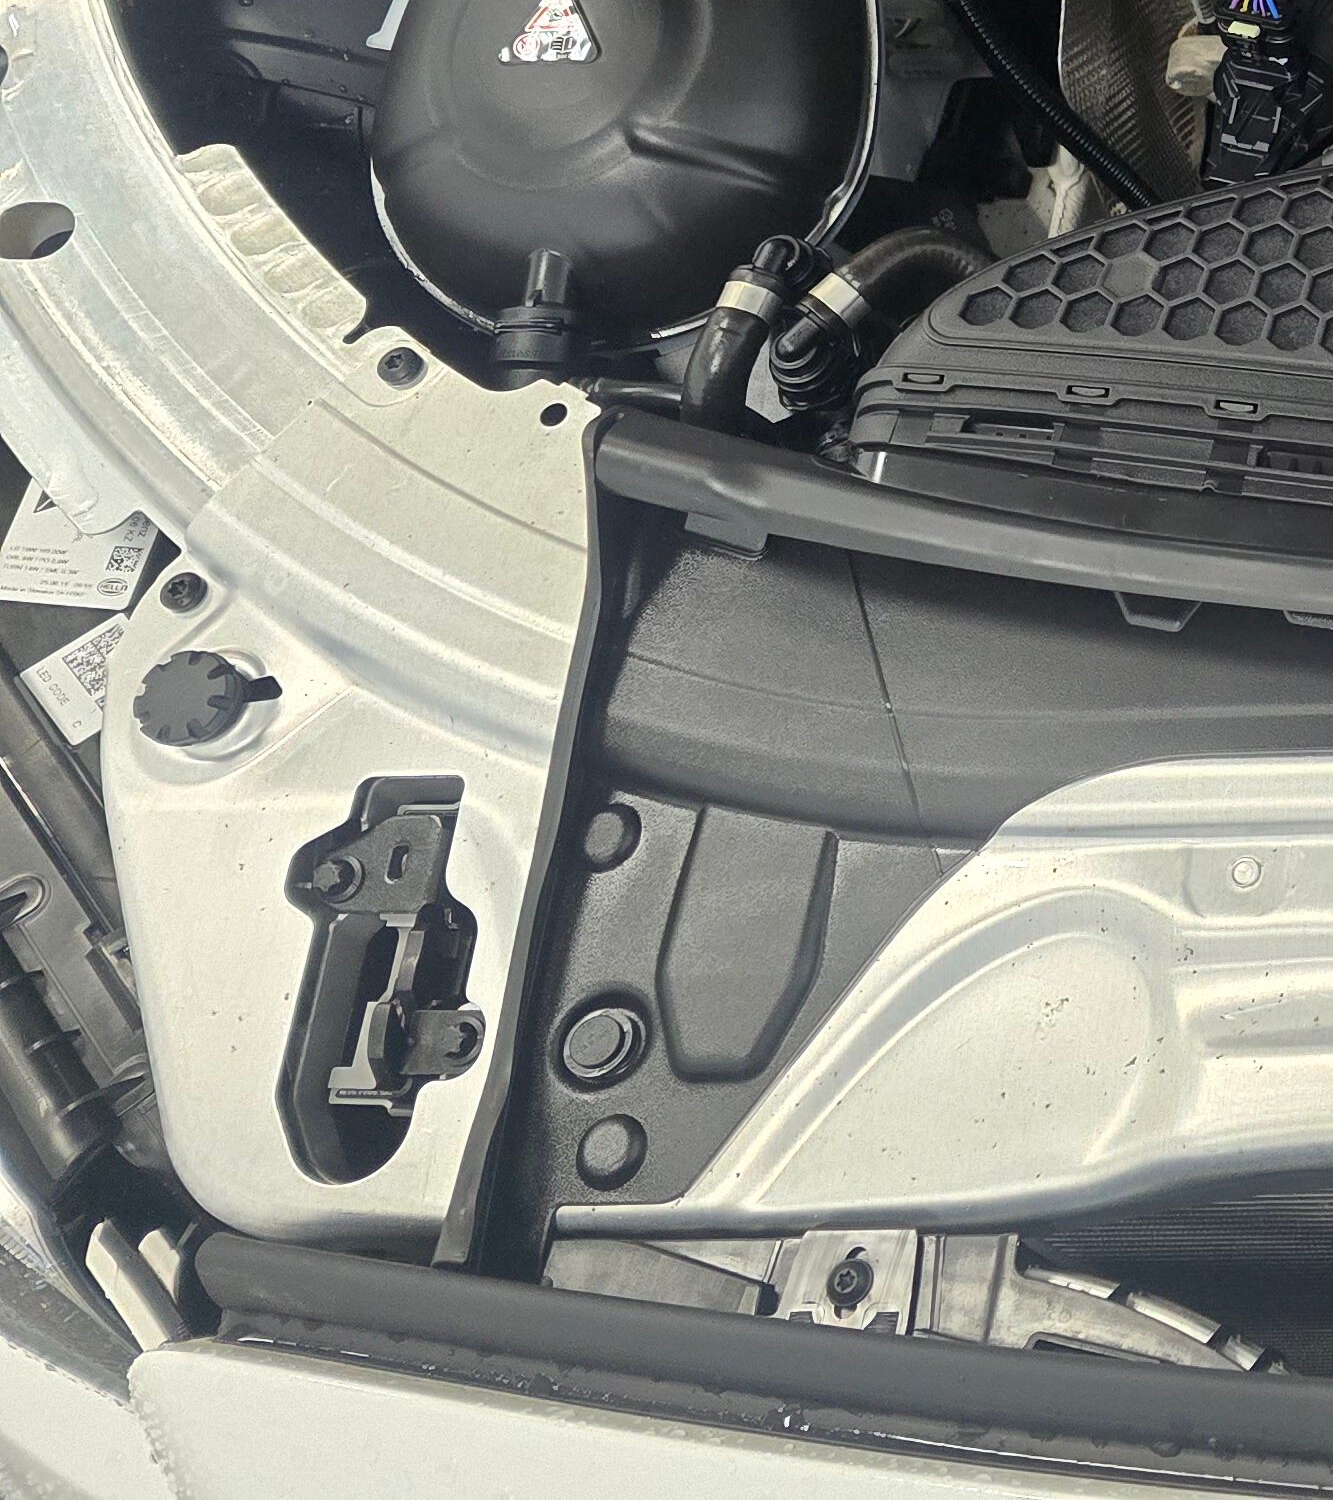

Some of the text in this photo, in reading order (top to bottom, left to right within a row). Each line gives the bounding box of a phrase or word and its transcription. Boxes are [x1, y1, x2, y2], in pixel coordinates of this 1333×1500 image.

[123, 529, 135, 542] KZ
[36, 666, 82, 729] LED CODE C
